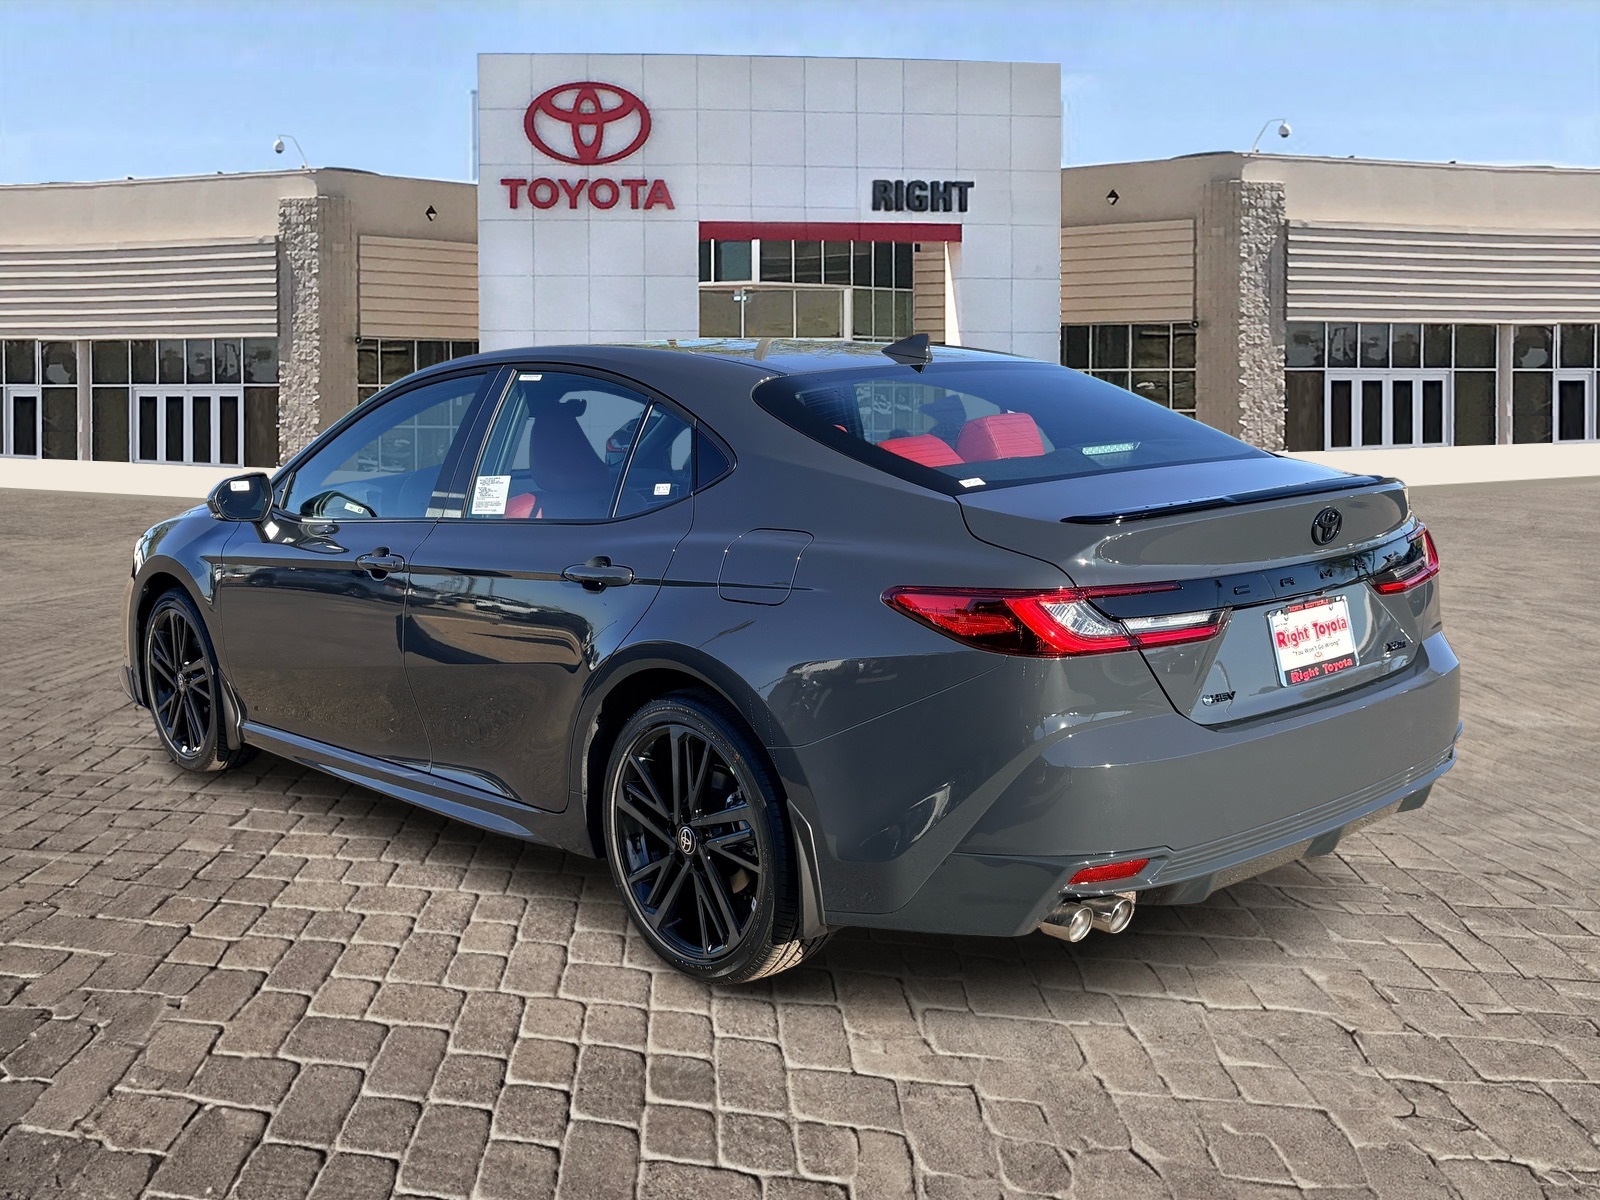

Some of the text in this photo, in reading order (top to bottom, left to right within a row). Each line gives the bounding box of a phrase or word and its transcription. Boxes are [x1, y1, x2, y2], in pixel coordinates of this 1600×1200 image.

[501, 178, 675, 210] TOYOTA
[871, 179, 976, 213] RIGHT
[1233, 550, 1398, 596] CAMRY
[1275, 618, 1347, 648] Right Toyota
[1290, 658, 1353, 683] Right Toyota
